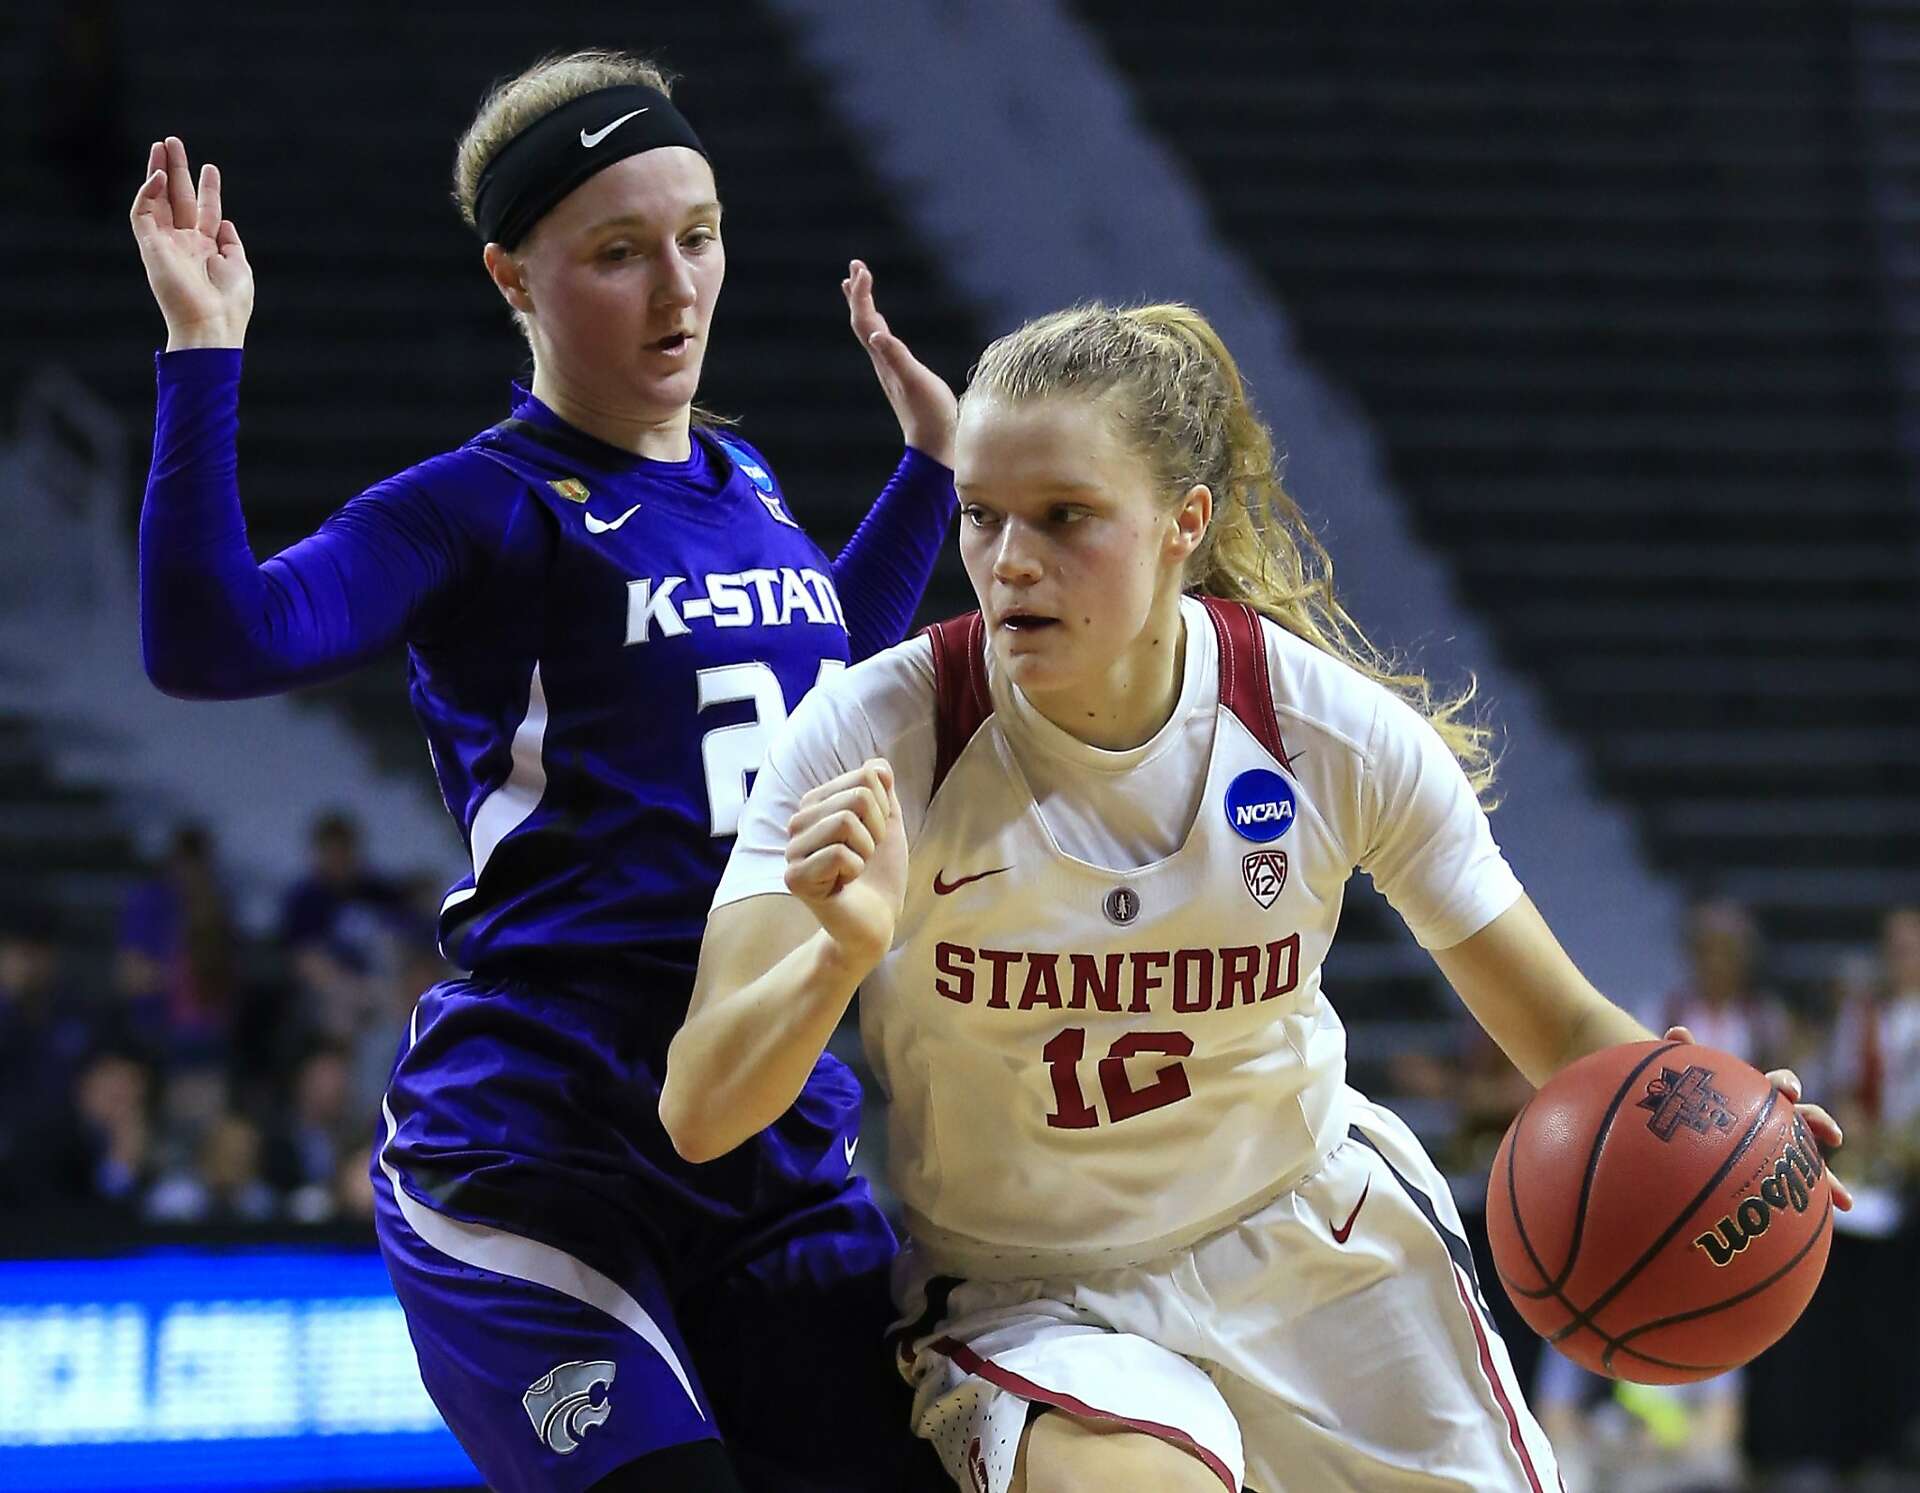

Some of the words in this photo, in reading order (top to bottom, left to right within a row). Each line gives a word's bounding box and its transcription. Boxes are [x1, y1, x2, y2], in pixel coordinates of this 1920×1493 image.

[1236, 800, 1293, 825] NCAA
[1247, 853, 1284, 886] PAC
[1254, 875, 1276, 897] 12
[935, 933, 1301, 1013] STANFORD
